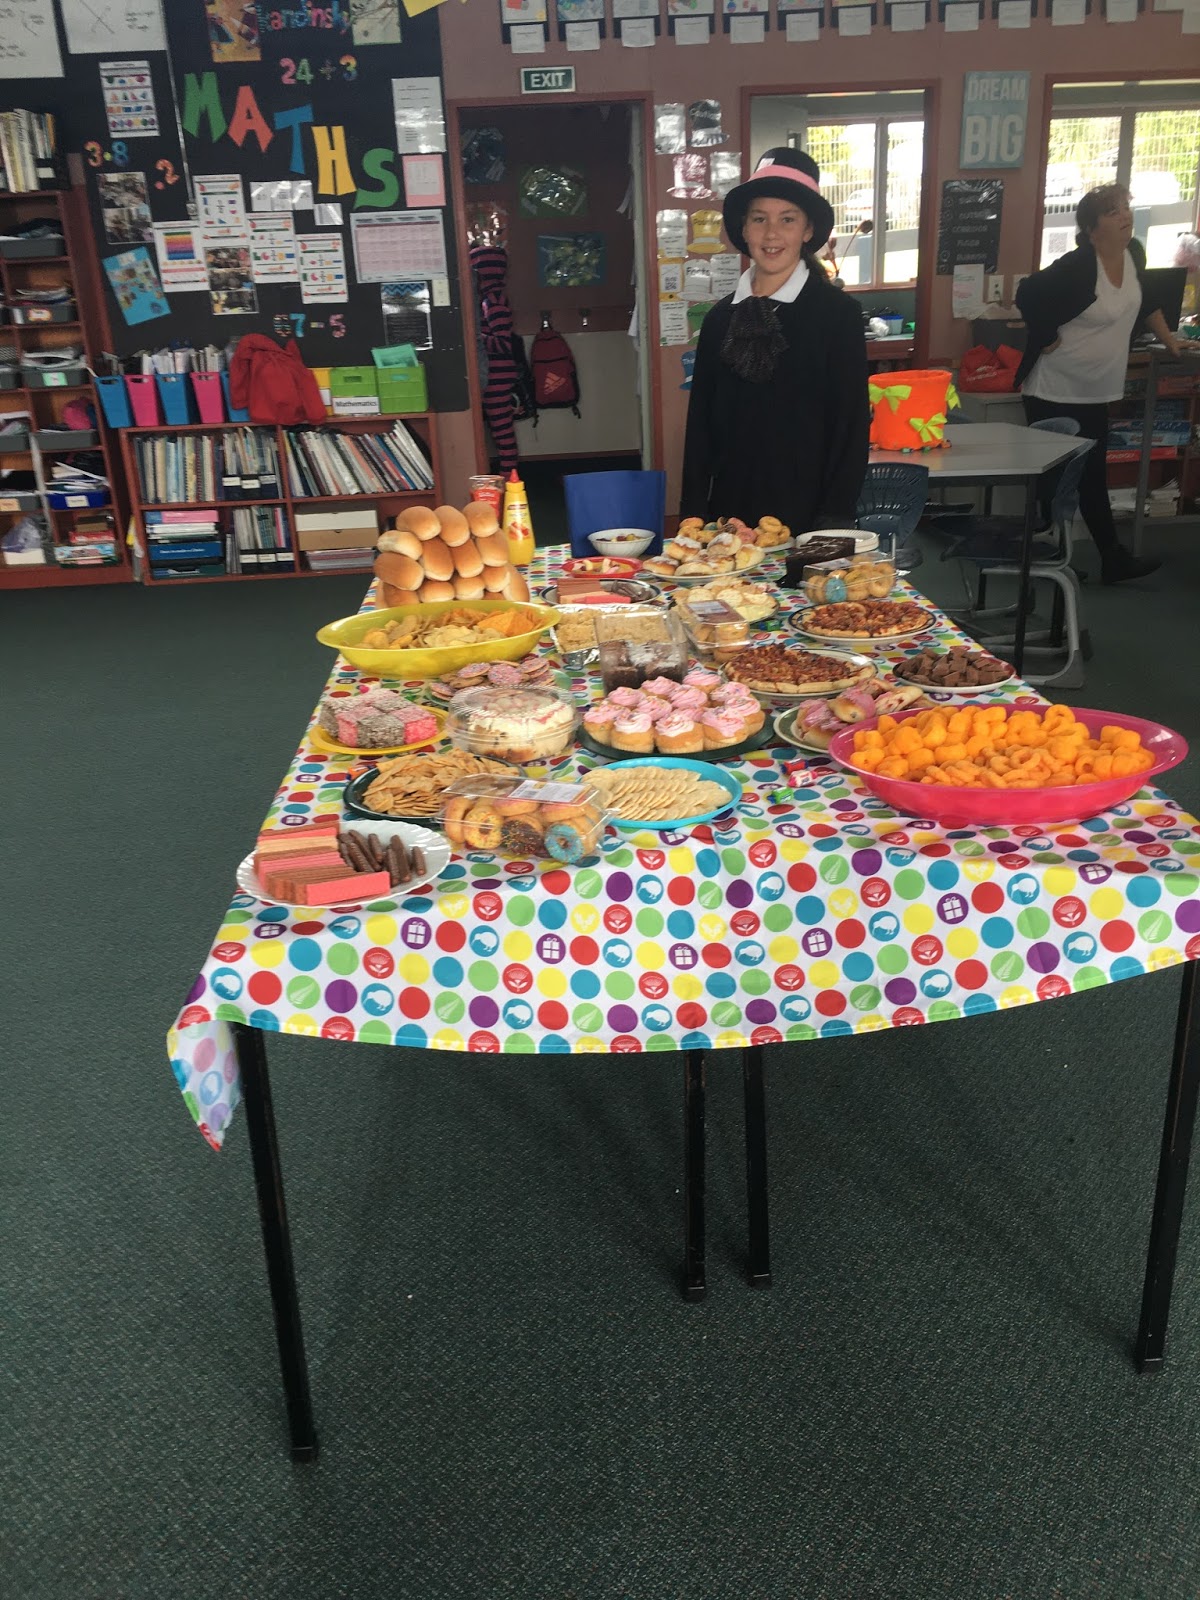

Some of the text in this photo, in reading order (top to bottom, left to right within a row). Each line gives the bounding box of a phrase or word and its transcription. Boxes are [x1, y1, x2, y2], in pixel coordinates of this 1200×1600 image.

[280, 58, 314, 85] 24
[530, 72, 565, 88] EXIT
[966, 78, 1027, 101] DREAM
[183, 71, 401, 209] MATHS
[964, 114, 1024, 163] BIG
[335, 400, 378, 408] Mathematics
